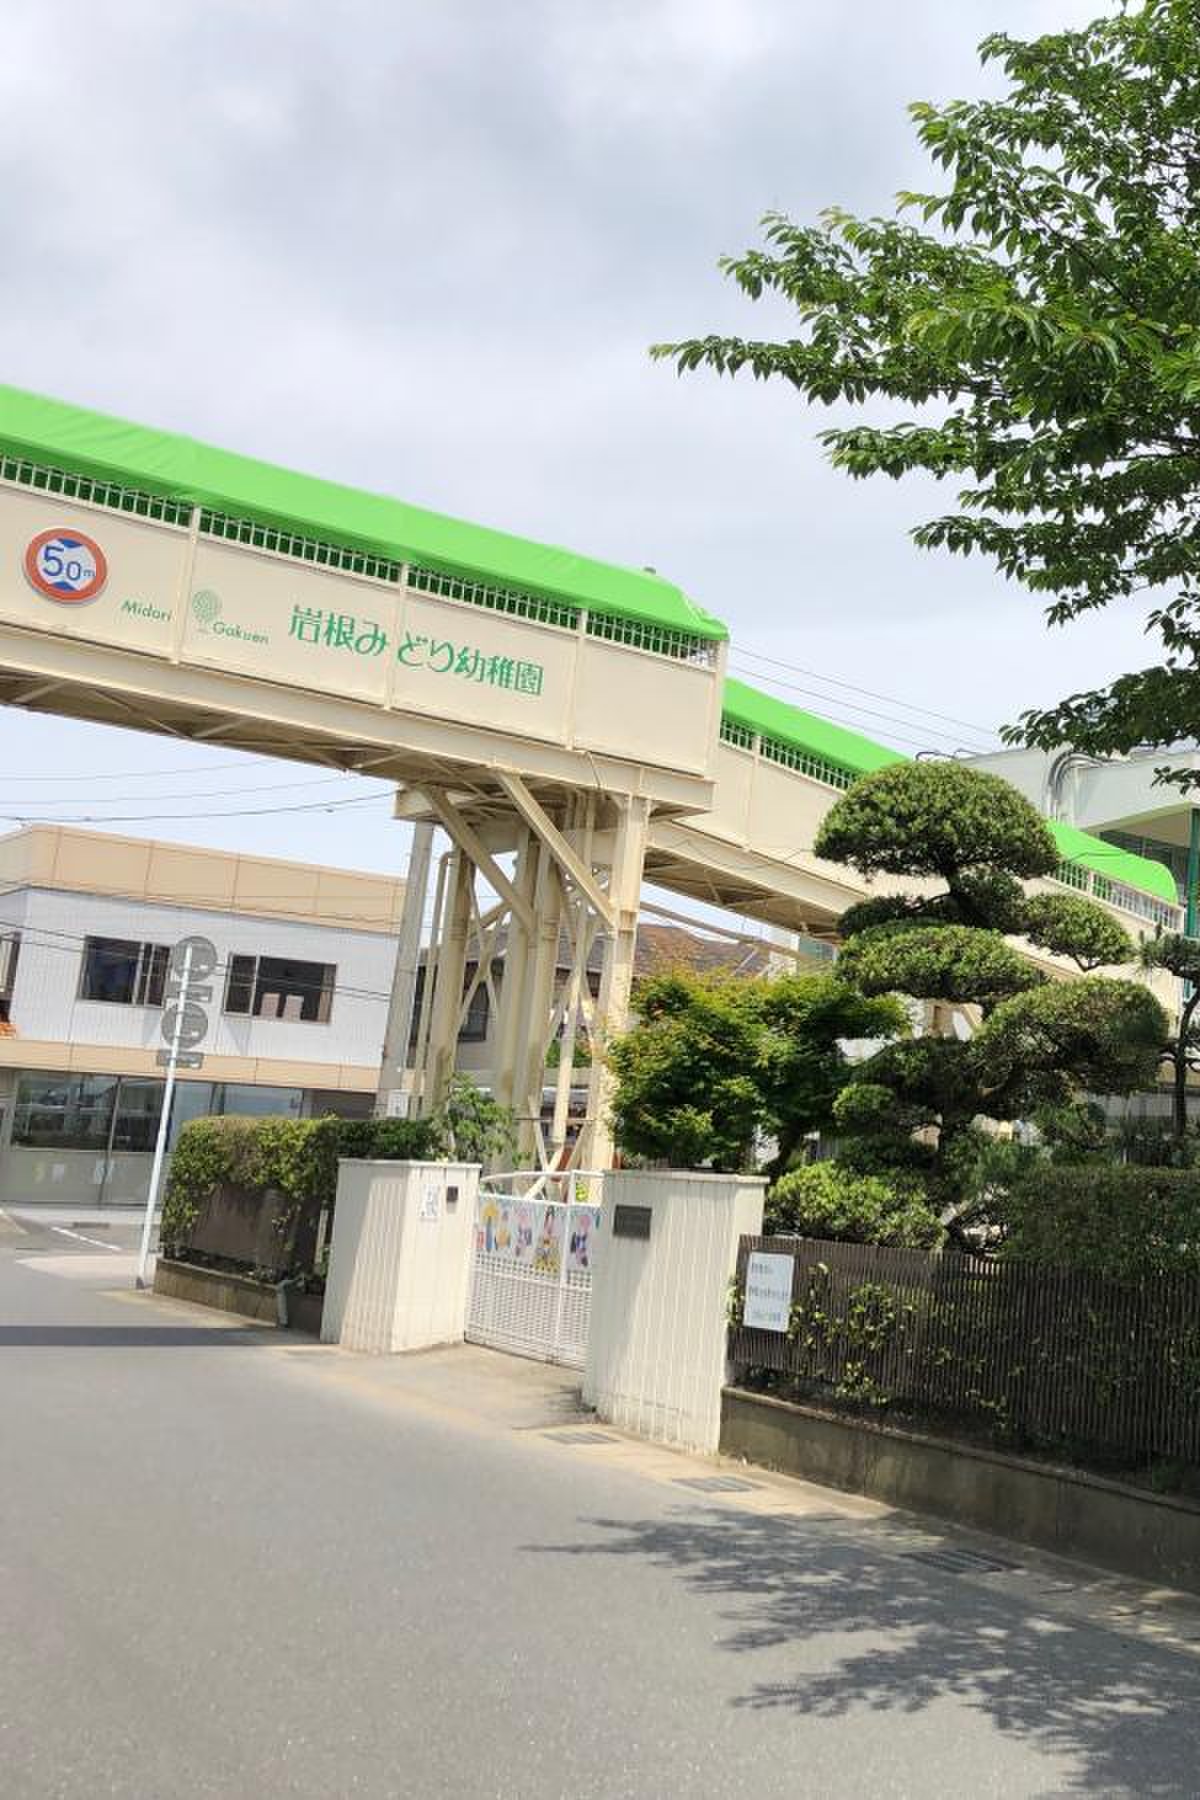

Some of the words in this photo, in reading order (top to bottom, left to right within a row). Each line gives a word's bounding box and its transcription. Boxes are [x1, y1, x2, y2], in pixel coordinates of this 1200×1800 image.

[121, 599, 172, 622] Midori
[212, 621, 269, 645] Gakuen
[288, 604, 543, 697] 岩根みどり幼稚園
